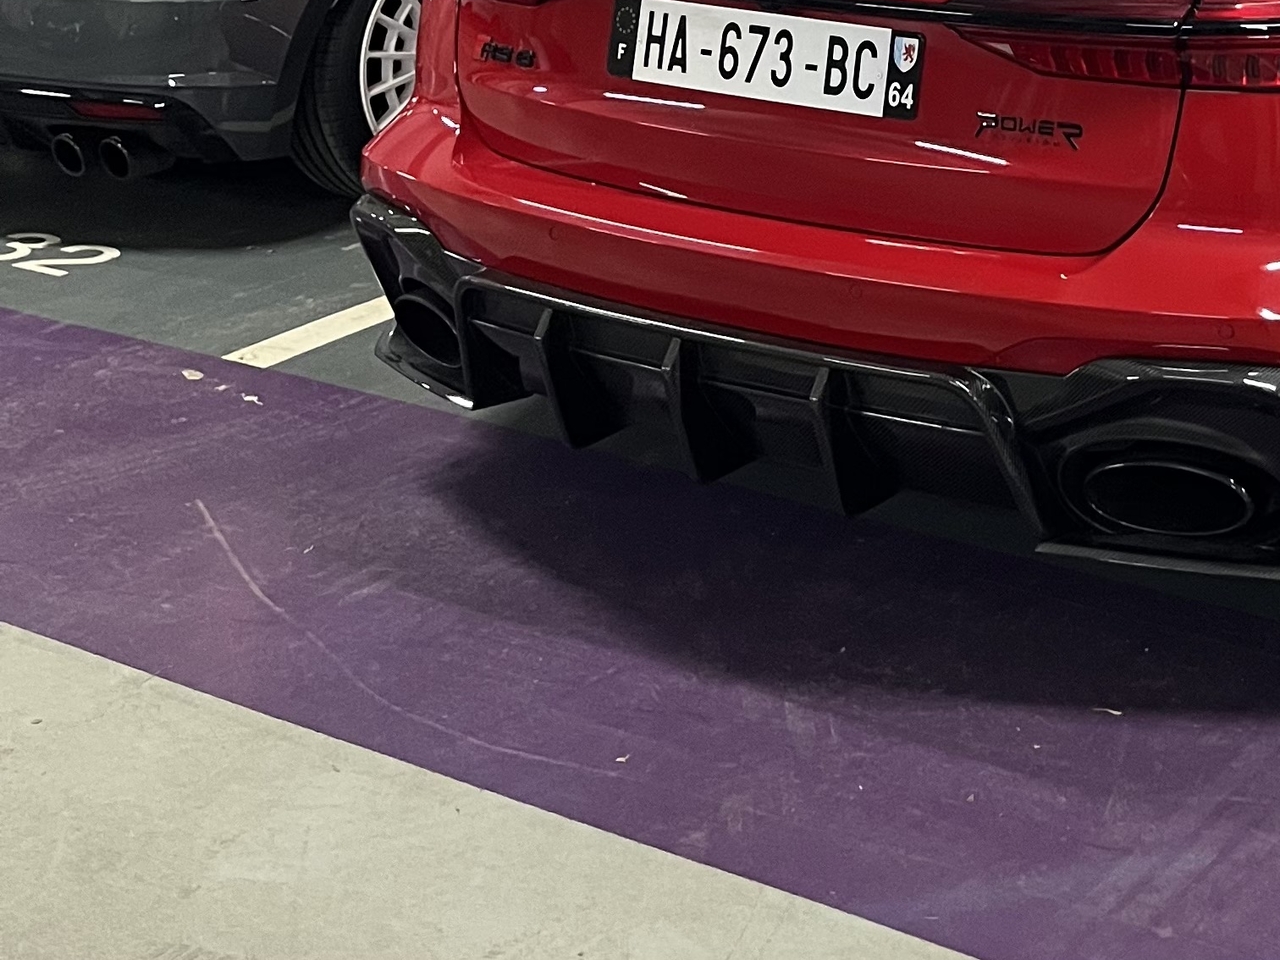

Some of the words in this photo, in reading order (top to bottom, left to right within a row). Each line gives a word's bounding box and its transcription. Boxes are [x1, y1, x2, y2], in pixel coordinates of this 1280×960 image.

[616, 42, 628, 60] F
[888, 82, 914, 110] 64
[974, 111, 1083, 151] POWER
